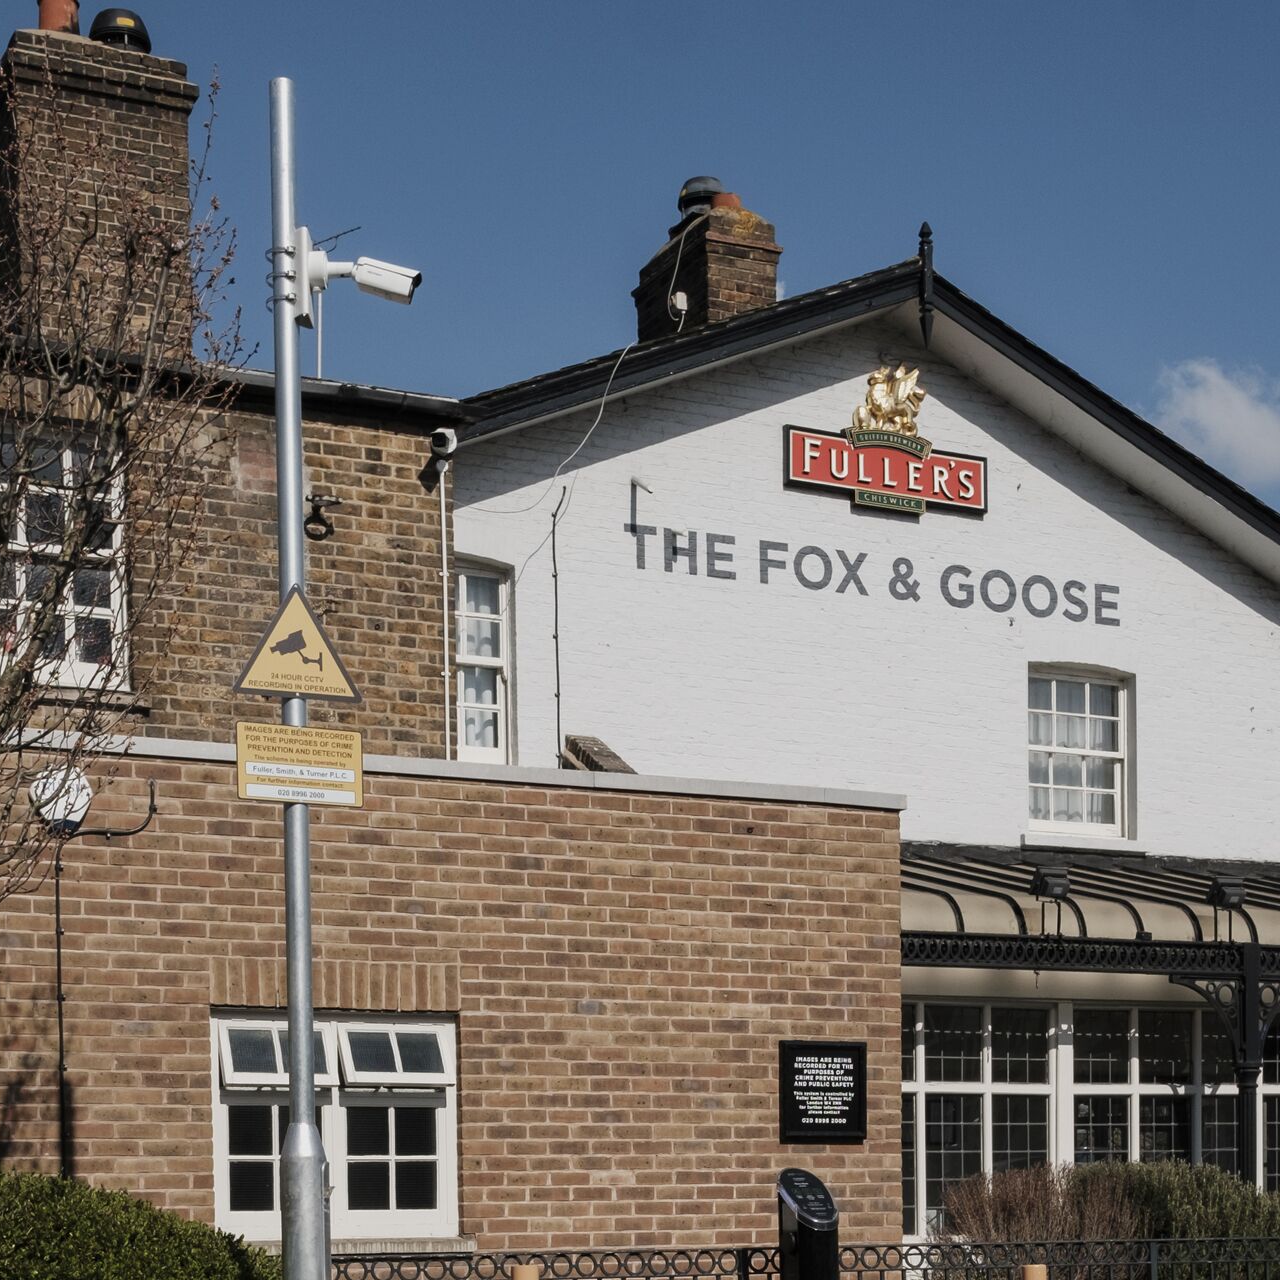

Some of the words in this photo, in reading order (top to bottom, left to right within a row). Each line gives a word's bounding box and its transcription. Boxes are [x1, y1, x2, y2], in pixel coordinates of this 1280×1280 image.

[889, 435, 921, 451] BREWERY
[801, 436, 976, 501] FULLER'S
[863, 492, 918, 508] CHISWICK
[623, 523, 737, 580] THE
[758, 539, 869, 597] FOX
[888, 557, 921, 602] &
[940, 564, 1121, 627] GOOSE
[248, 680, 293, 690] RECORDING
[295, 683, 302, 691] IN
[304, 684, 346, 694] OPERATION
[244, 725, 272, 734] IMAGES
[274, 727, 289, 735] ARE
[291, 728, 313, 737] BEING
[315, 731, 355, 741] RECORDED
[279, 737, 318, 747] PURPOSES
[331, 741, 353, 750] CRIME
[248, 744, 293, 754] PREVENTION
[295, 747, 311, 755] AND
[312, 749, 352, 758] DETECTION
[296, 758, 312, 766] being
[253, 766, 273, 775] Fuller,
[307, 770, 328, 778] Turner
[288, 779, 322, 787] information
